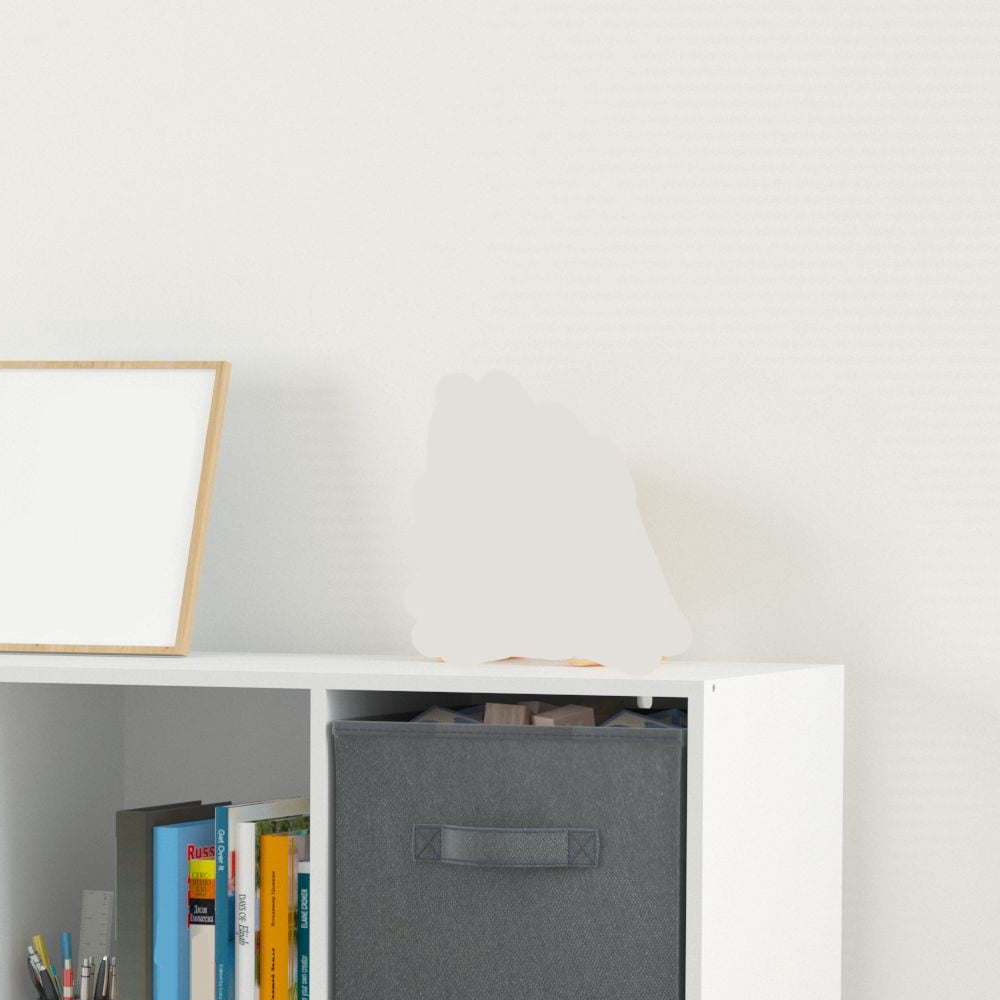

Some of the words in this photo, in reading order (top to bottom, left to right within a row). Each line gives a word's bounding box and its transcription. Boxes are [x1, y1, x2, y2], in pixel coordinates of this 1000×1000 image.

[217, 829, 225, 843] Get
[217, 845, 225, 863] Over
[238, 894, 247, 911] DAYS
[238, 912, 247, 922] OF
[236, 923, 249, 946] Elijah
